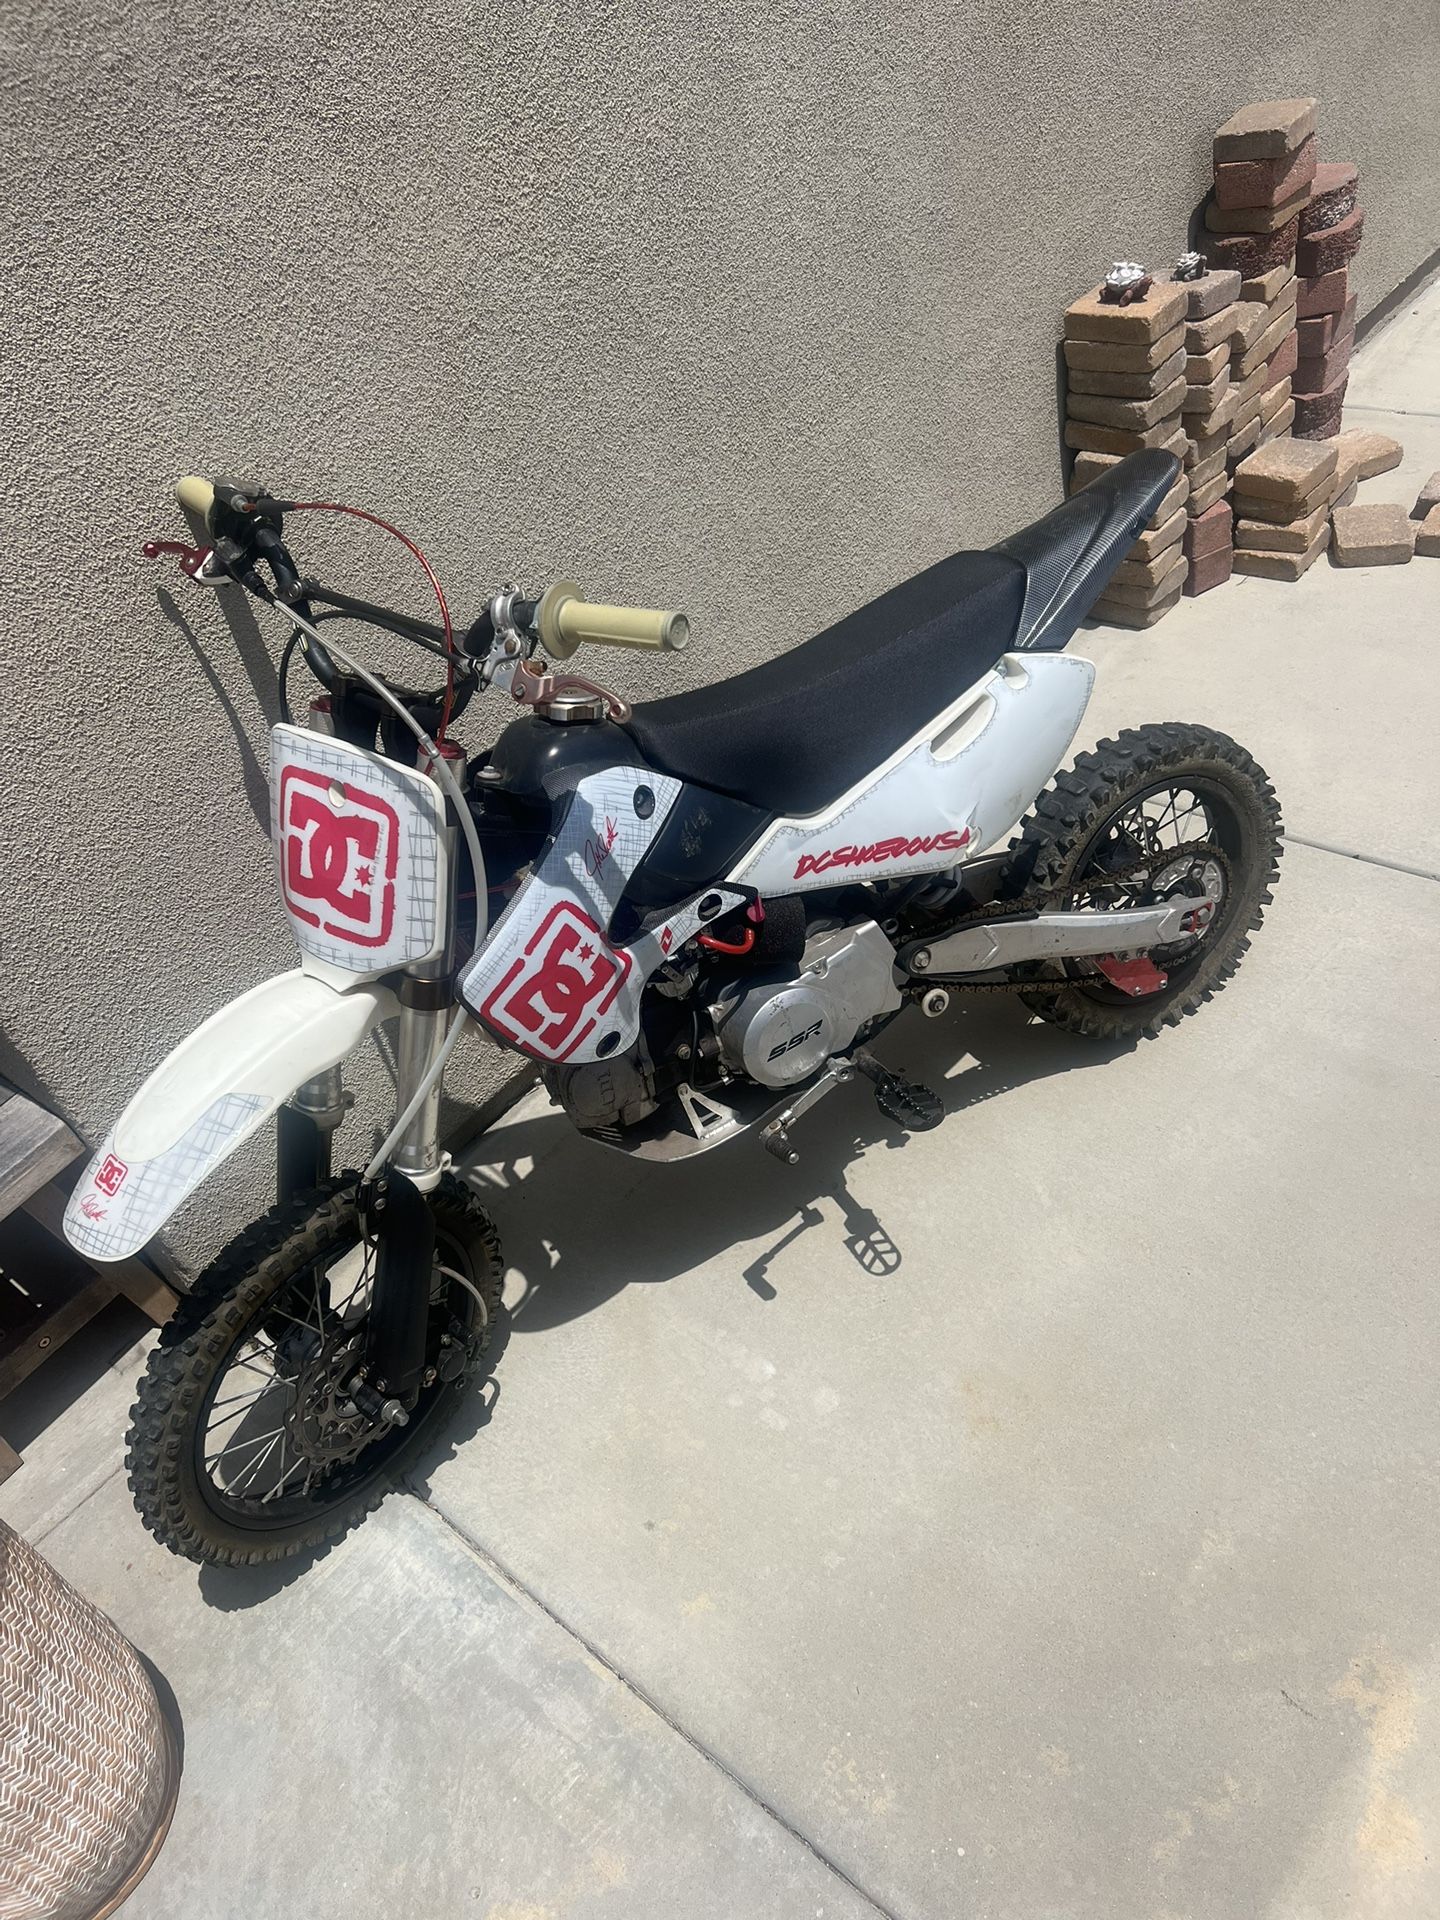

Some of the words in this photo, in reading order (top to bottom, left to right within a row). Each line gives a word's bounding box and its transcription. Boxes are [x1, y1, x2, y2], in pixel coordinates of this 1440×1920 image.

[288, 791, 380, 924] DC
[766, 1018, 823, 1063] SSR
[98, 1159, 124, 1192] DC
